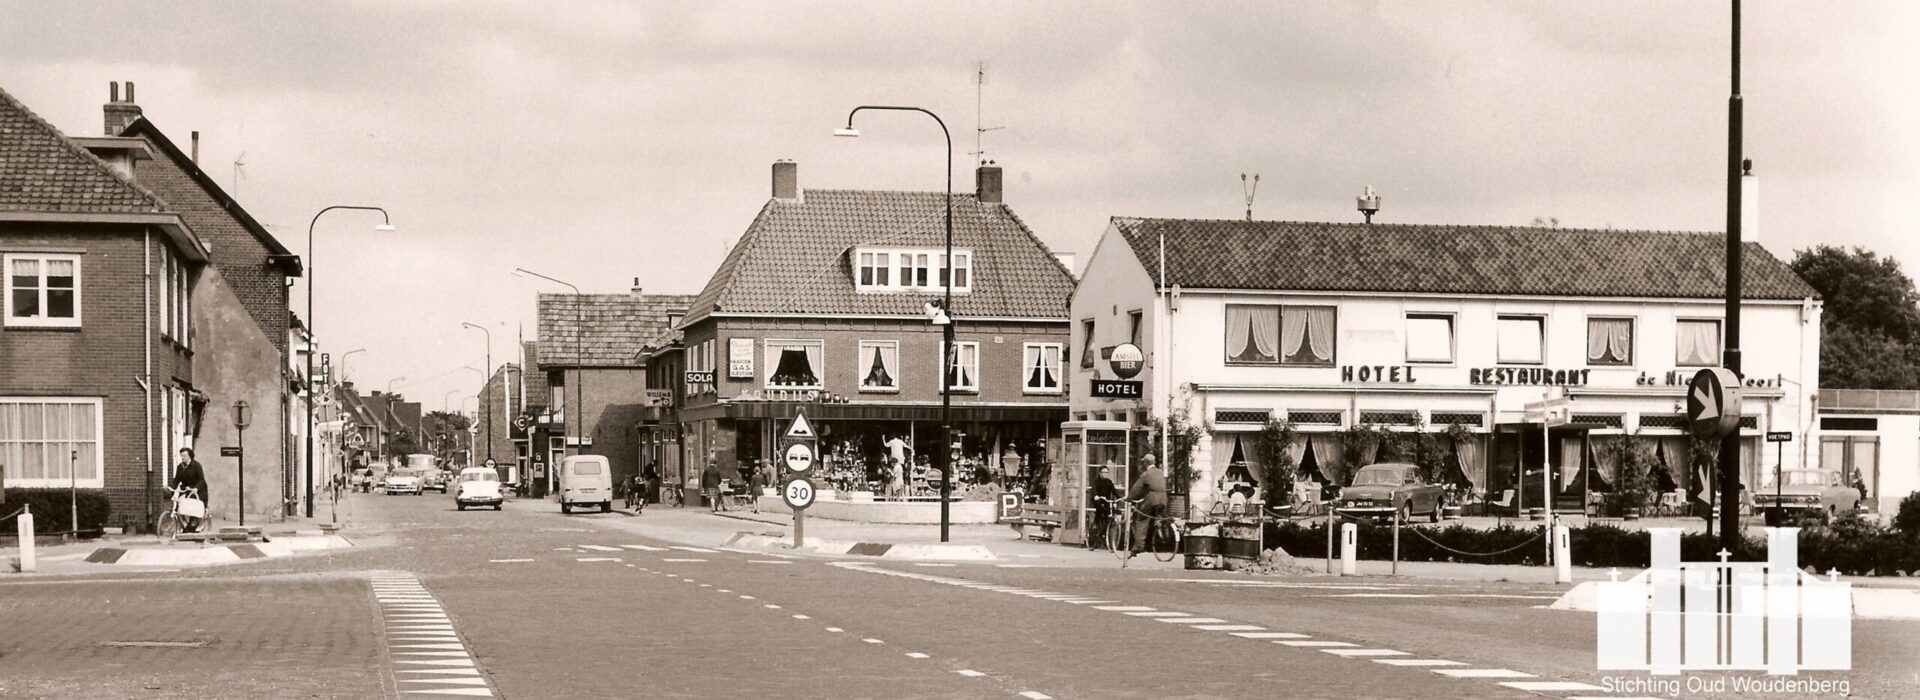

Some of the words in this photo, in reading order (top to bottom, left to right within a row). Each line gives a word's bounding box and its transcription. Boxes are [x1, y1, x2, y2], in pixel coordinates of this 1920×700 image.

[1120, 361, 1136, 369] BIER
[687, 373, 713, 383] SOLA
[1341, 365, 1417, 383] HOTEL
[1469, 367, 1591, 385] RESTAURANT
[1635, 370, 1656, 386] de
[1098, 384, 1137, 395] HOTEL
[1087, 432, 1126, 443] telefoon
[790, 486, 809, 500] 30
[1002, 494, 1018, 517] P
